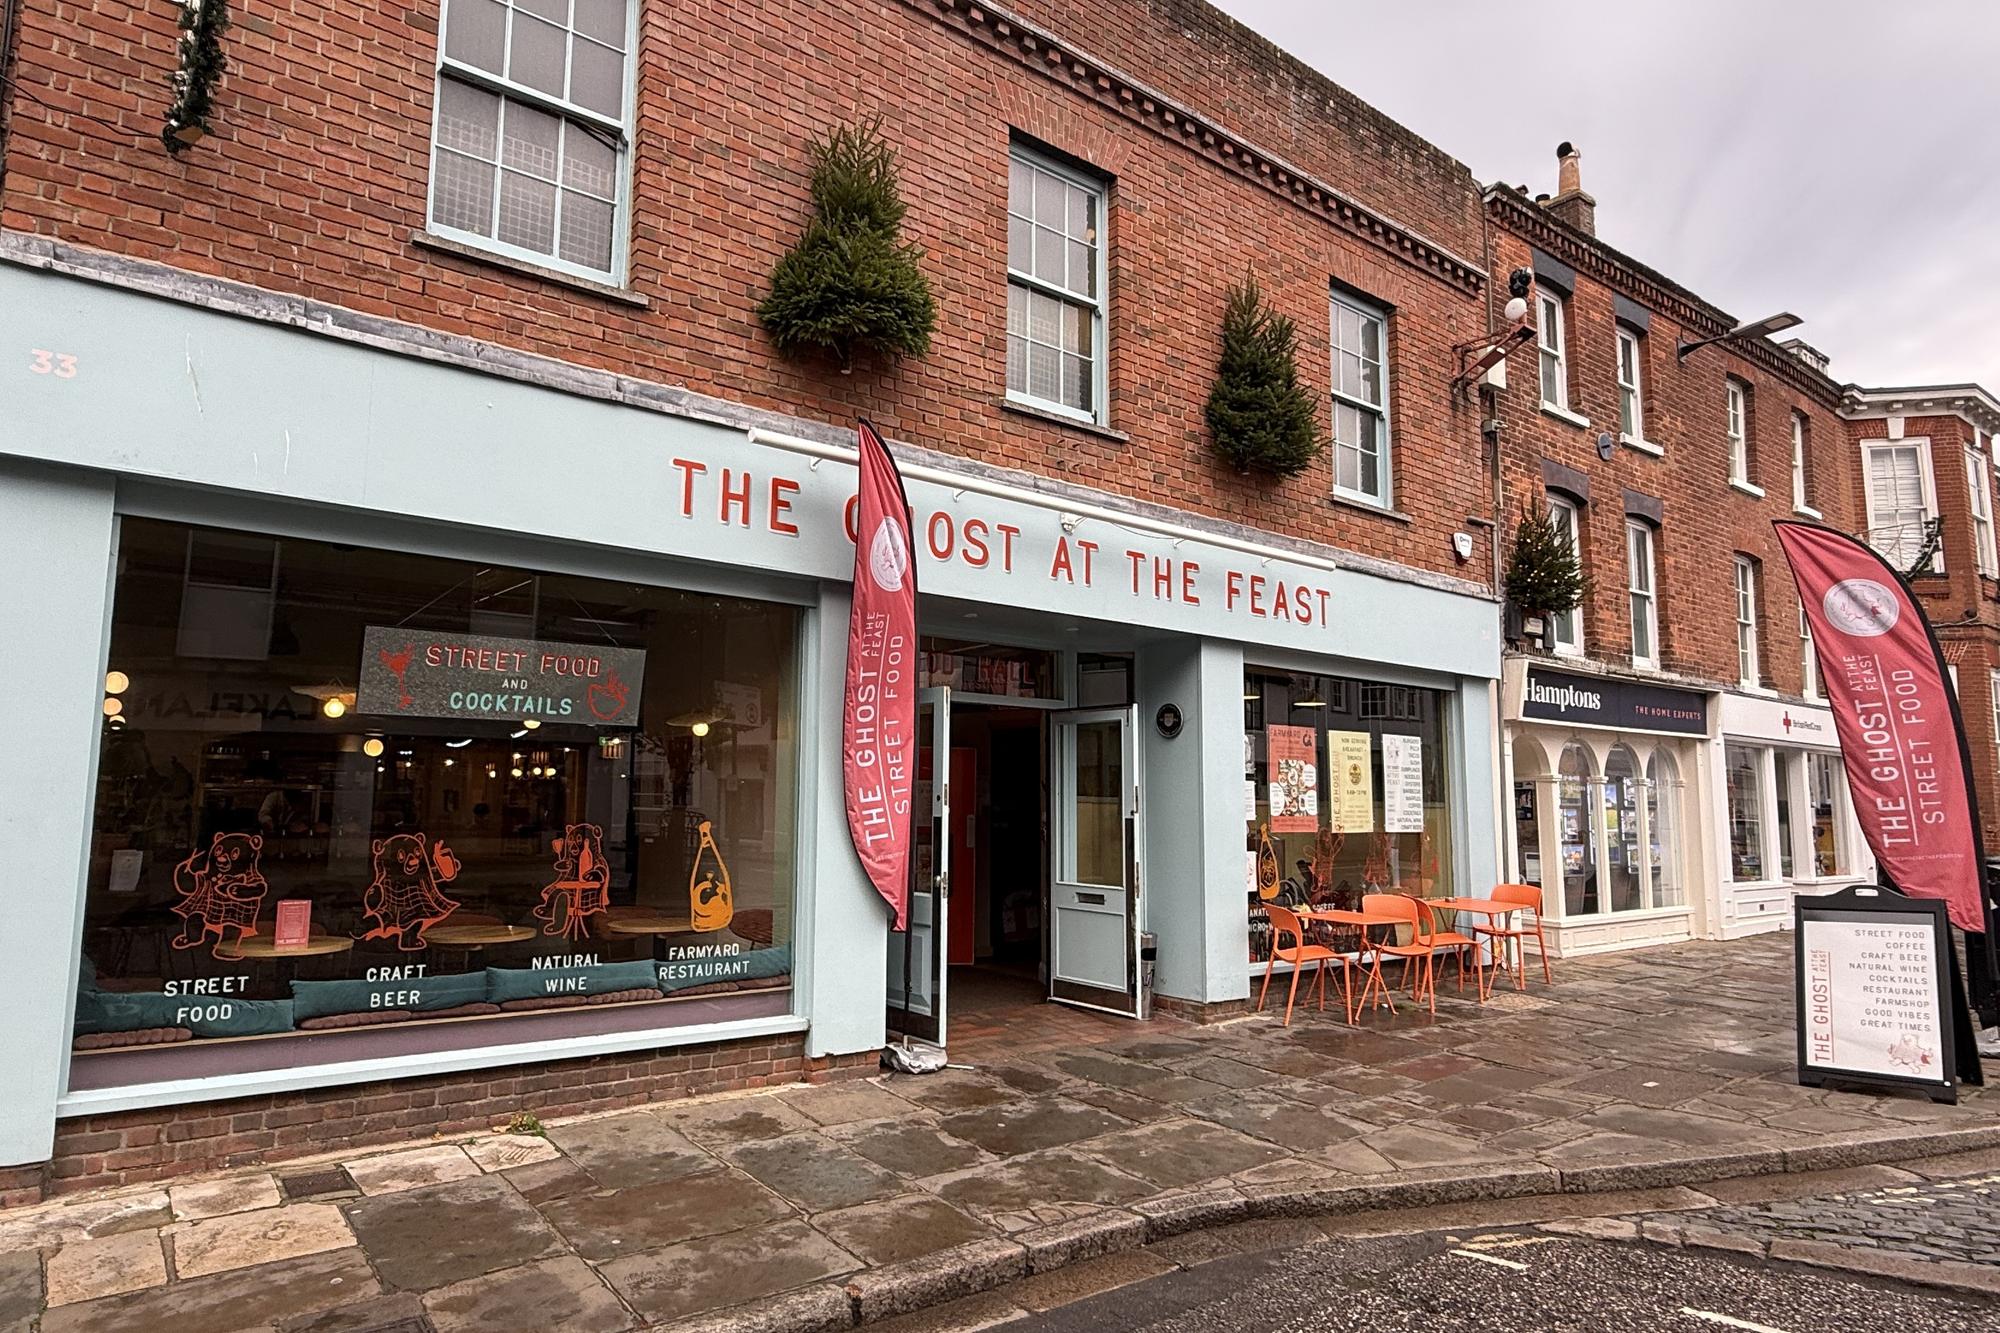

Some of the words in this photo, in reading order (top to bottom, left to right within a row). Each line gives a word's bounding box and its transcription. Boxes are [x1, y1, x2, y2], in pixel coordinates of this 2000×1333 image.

[29, 348, 78, 378] 33
[671, 457, 801, 536] THE
[843, 494, 1021, 574] OST
[1050, 535, 1099, 587] AT
[1125, 550, 1201, 606] THE
[1226, 570, 1331, 628] FEAST
[871, 611, 886, 657] FEAST
[425, 644, 528, 673] STREET
[540, 654, 601, 677] FOOD
[885, 635, 904, 699] FOOD
[1858, 654, 1879, 691] FEAST
[502, 678, 528, 690] AND
[449, 691, 573, 715] COCKTAILS
[1524, 677, 1601, 713] Hamptons
[1635, 705, 1648, 715] THE
[1651, 707, 1671, 718] HOME
[1673, 709, 1701, 721] EXPERTS
[1891, 669, 1926, 724] FOOD
[855, 666, 878, 768] GHOST
[1855, 699, 1900, 782] GHOST
[884, 717, 910, 816] STREET
[1908, 738, 1945, 824] STREET
[858, 784, 889, 848] THE
[1876, 796, 1911, 848] THE
[1854, 929, 1893, 938] STREET
[1898, 930, 1925, 939] FOOD
[669, 943, 740, 960] FARMYARD
[1861, 951, 1894, 961] CRAFT
[1899, 953, 1928, 962] BEER
[1885, 942, 1926, 951] COFFEE
[531, 952, 603, 970] NATURAL
[658, 960, 750, 980] RESTAURANT
[1819, 950, 1828, 973] FEAST
[1849, 962, 1895, 972] NATURAL
[1899, 964, 1928, 973] WINE
[365, 963, 427, 983] CRAFT
[1868, 974, 1928, 985] COCKTAILS
[163, 975, 249, 997] STREET
[545, 976, 587, 993] WINE
[1862, 985, 1929, 996] RESTAURANT
[369, 989, 421, 1008] BEER
[1811, 975, 1829, 1025] GHOST
[1875, 998, 1930, 1007] FARMSHOP
[176, 1004, 233, 1024] FOOD
[1864, 1008, 1893, 1017] GOOD
[1897, 1010, 1931, 1020] VIBES
[1860, 1019, 1893, 1029] GREAT
[1899, 1022, 1931, 1032] TIMES
[1814, 1033, 1831, 1062] THE
